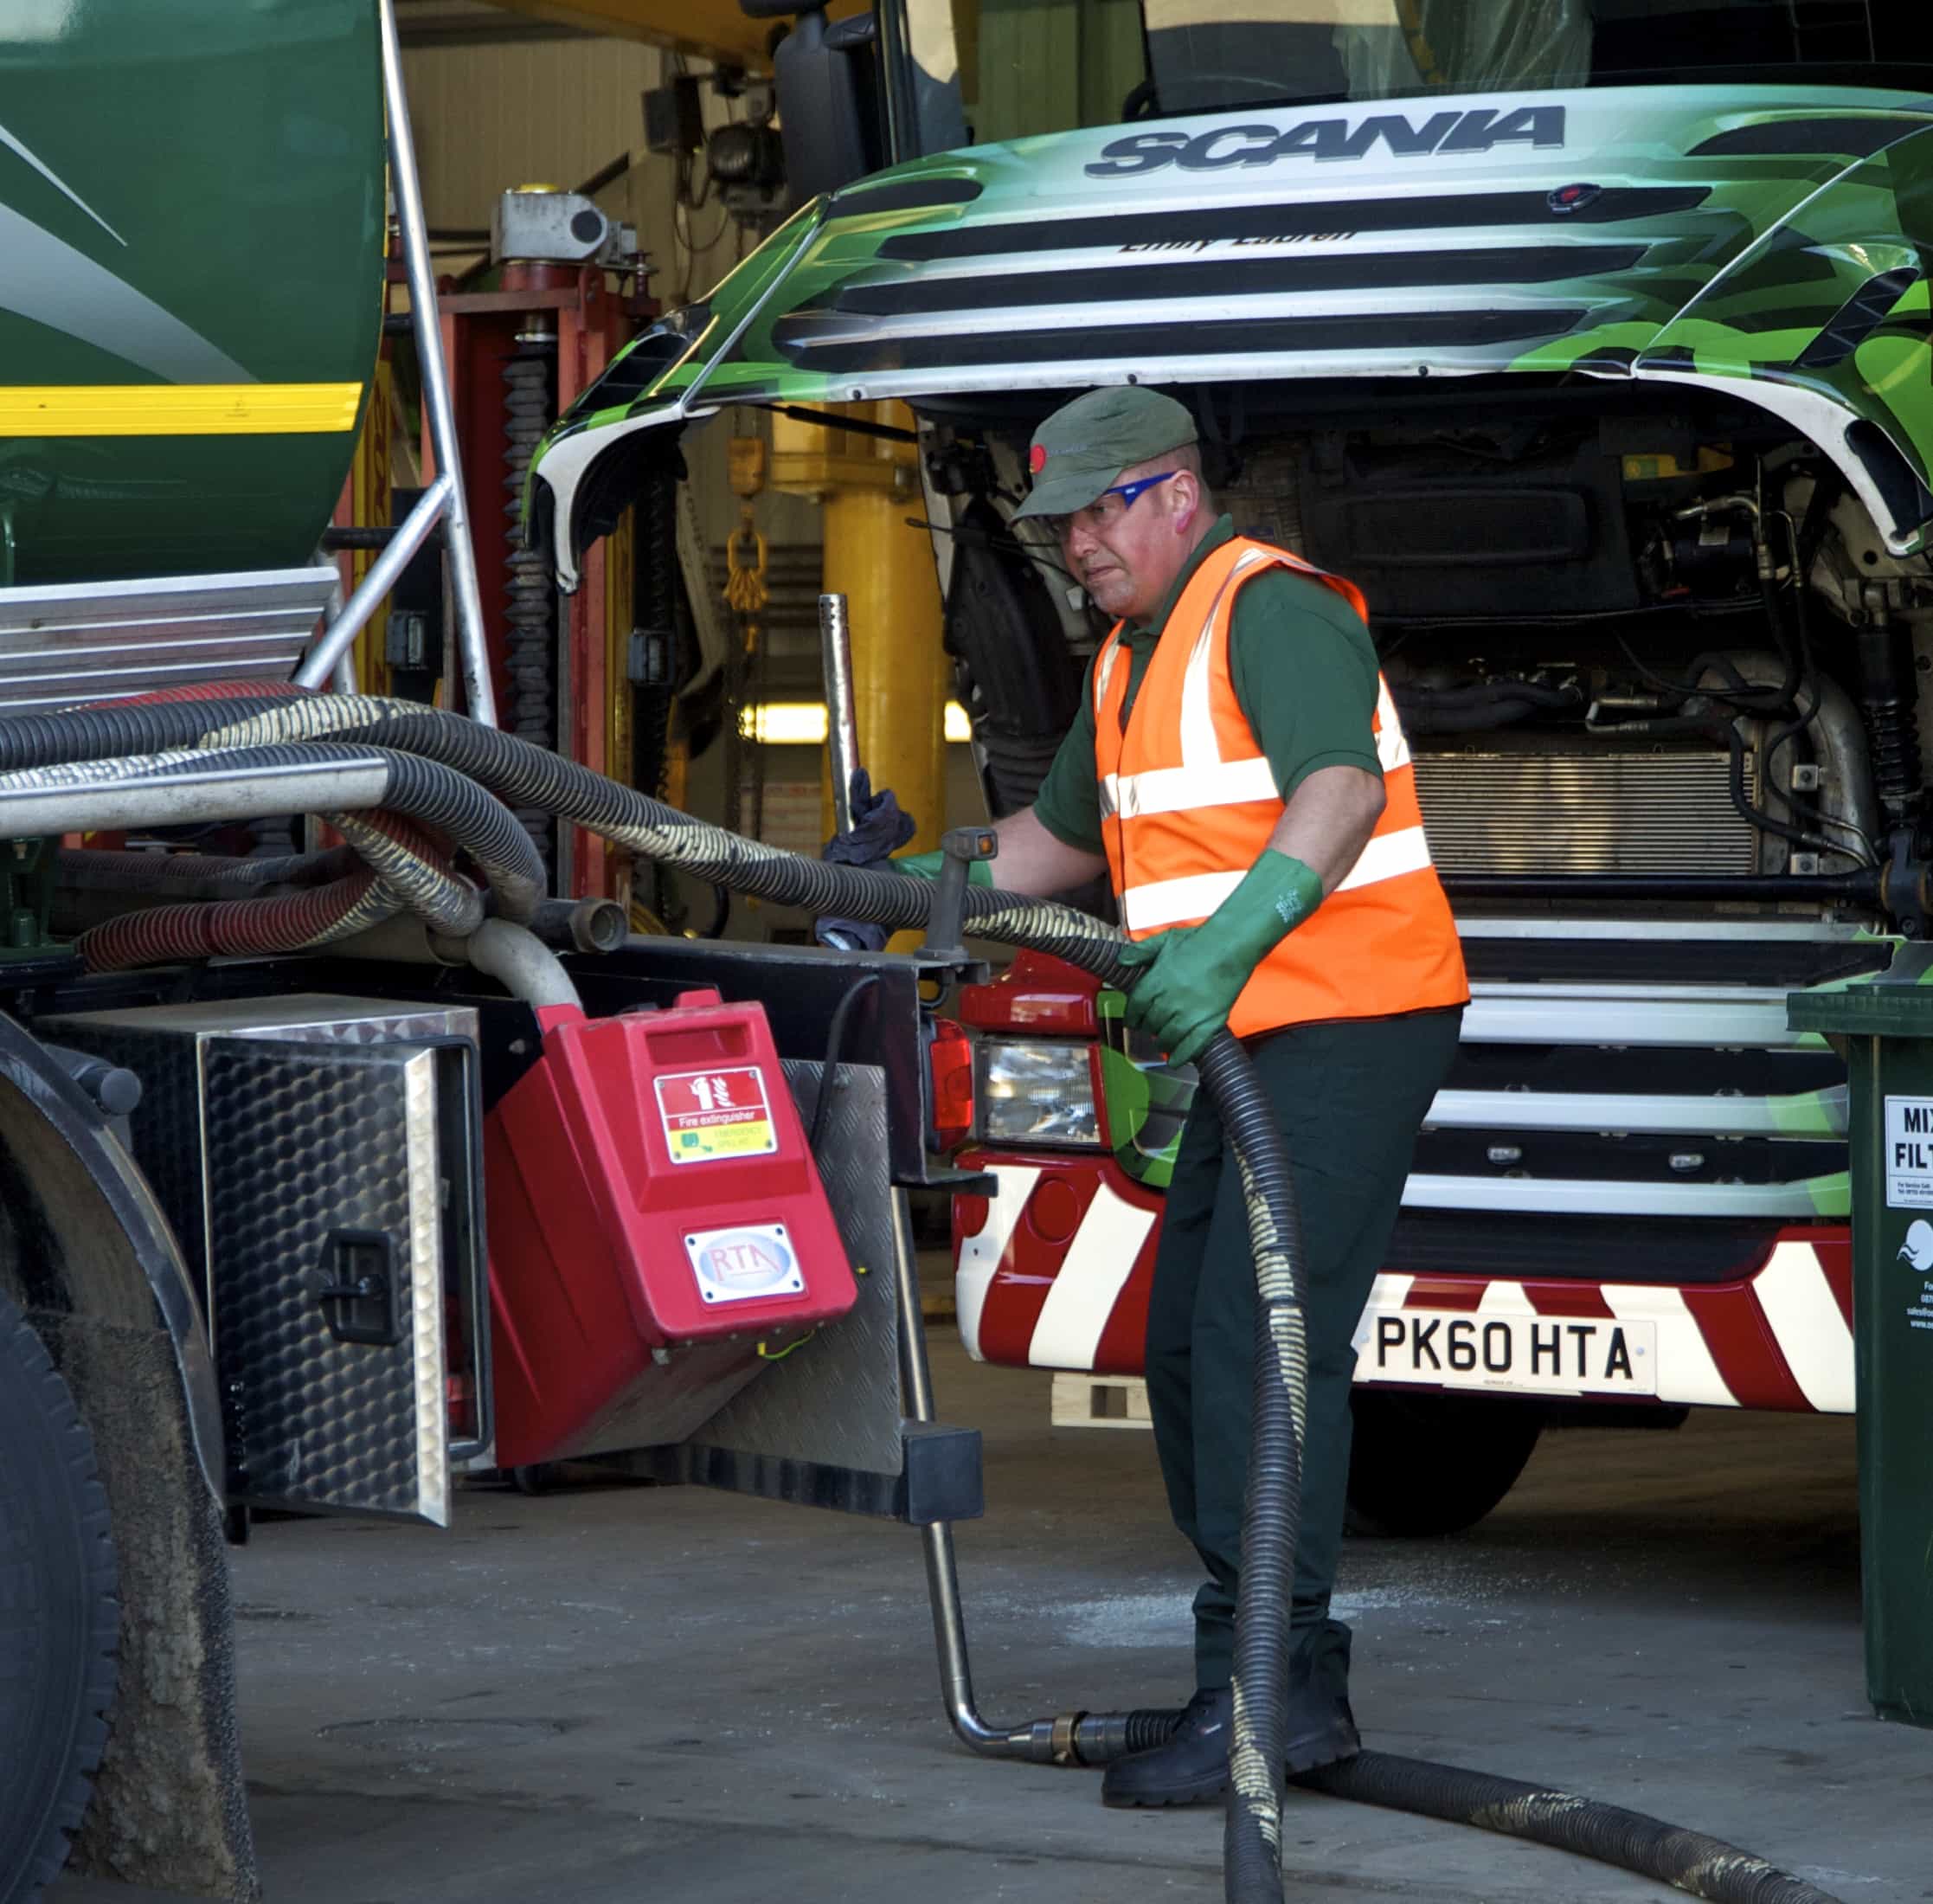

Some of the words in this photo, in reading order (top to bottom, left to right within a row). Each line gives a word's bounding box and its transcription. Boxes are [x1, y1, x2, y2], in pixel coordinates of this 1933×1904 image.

[1083, 105, 1565, 179] SCANIA
[678, 1116, 698, 1128] Fire
[699, 1111, 755, 1126] extinguisher
[1904, 1107, 1933, 1134] MI
[1377, 1315, 1512, 1373] PK60
[1530, 1322, 1634, 1380] HTA
